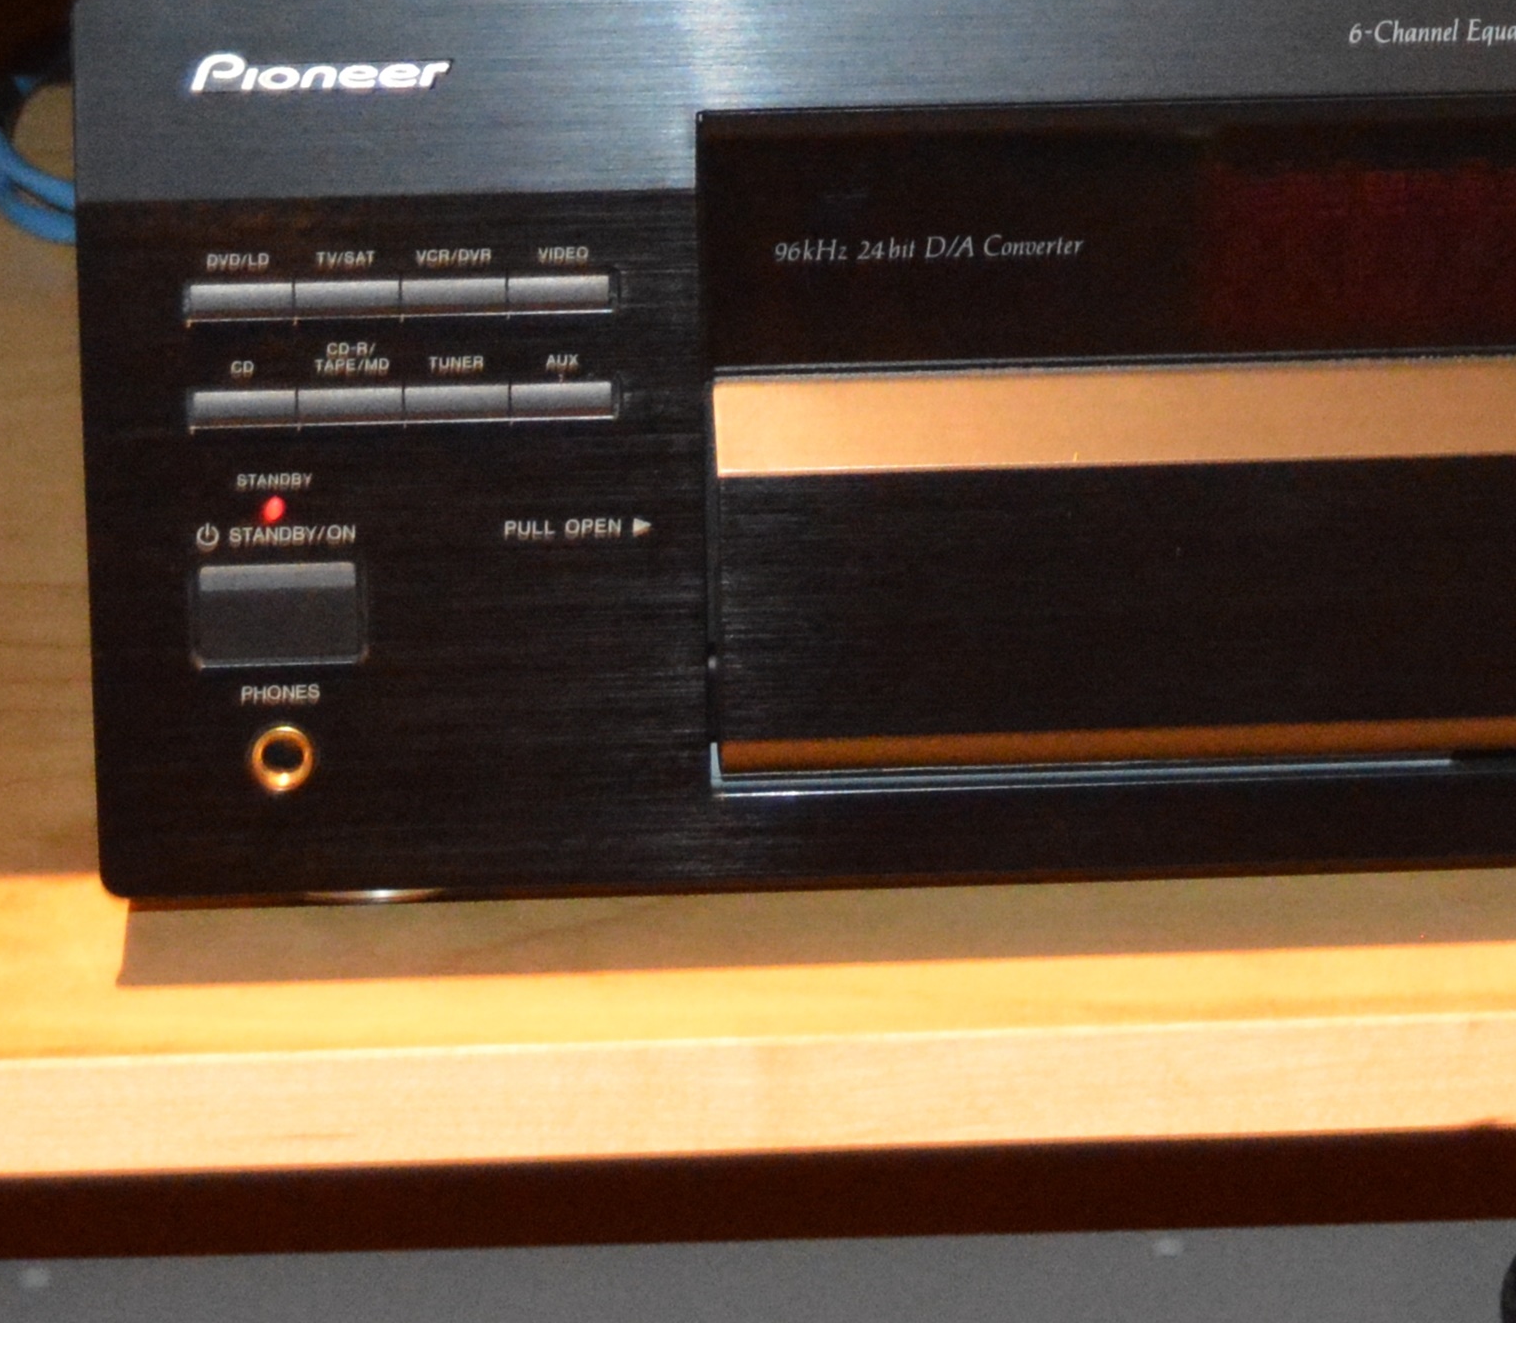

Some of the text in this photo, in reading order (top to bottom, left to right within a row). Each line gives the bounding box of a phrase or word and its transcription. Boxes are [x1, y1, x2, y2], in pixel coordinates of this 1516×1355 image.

[1349, 18, 1459, 44] 6-Channel
[190, 53, 451, 92] Pioneer
[416, 248, 492, 264] VCR/DVR
[538, 246, 589, 262] VIDEO
[775, 240, 847, 262] 96kHz
[925, 236, 974, 258] D/A
[984, 234, 1084, 258] Converter
[206, 253, 270, 268] DVD/LD
[316, 250, 375, 265] TV/SAT
[326, 342, 376, 358] CD-R/
[230, 360, 254, 376] CD
[314, 356, 390, 374] TAPE/MD
[429, 355, 484, 372] TUNER
[546, 353, 579, 370] AUX
[236, 472, 312, 489] STANDBY
[228, 523, 356, 545] STANDBY/ON
[504, 517, 622, 537] PULL OPEN
[241, 683, 320, 705] PHONES
